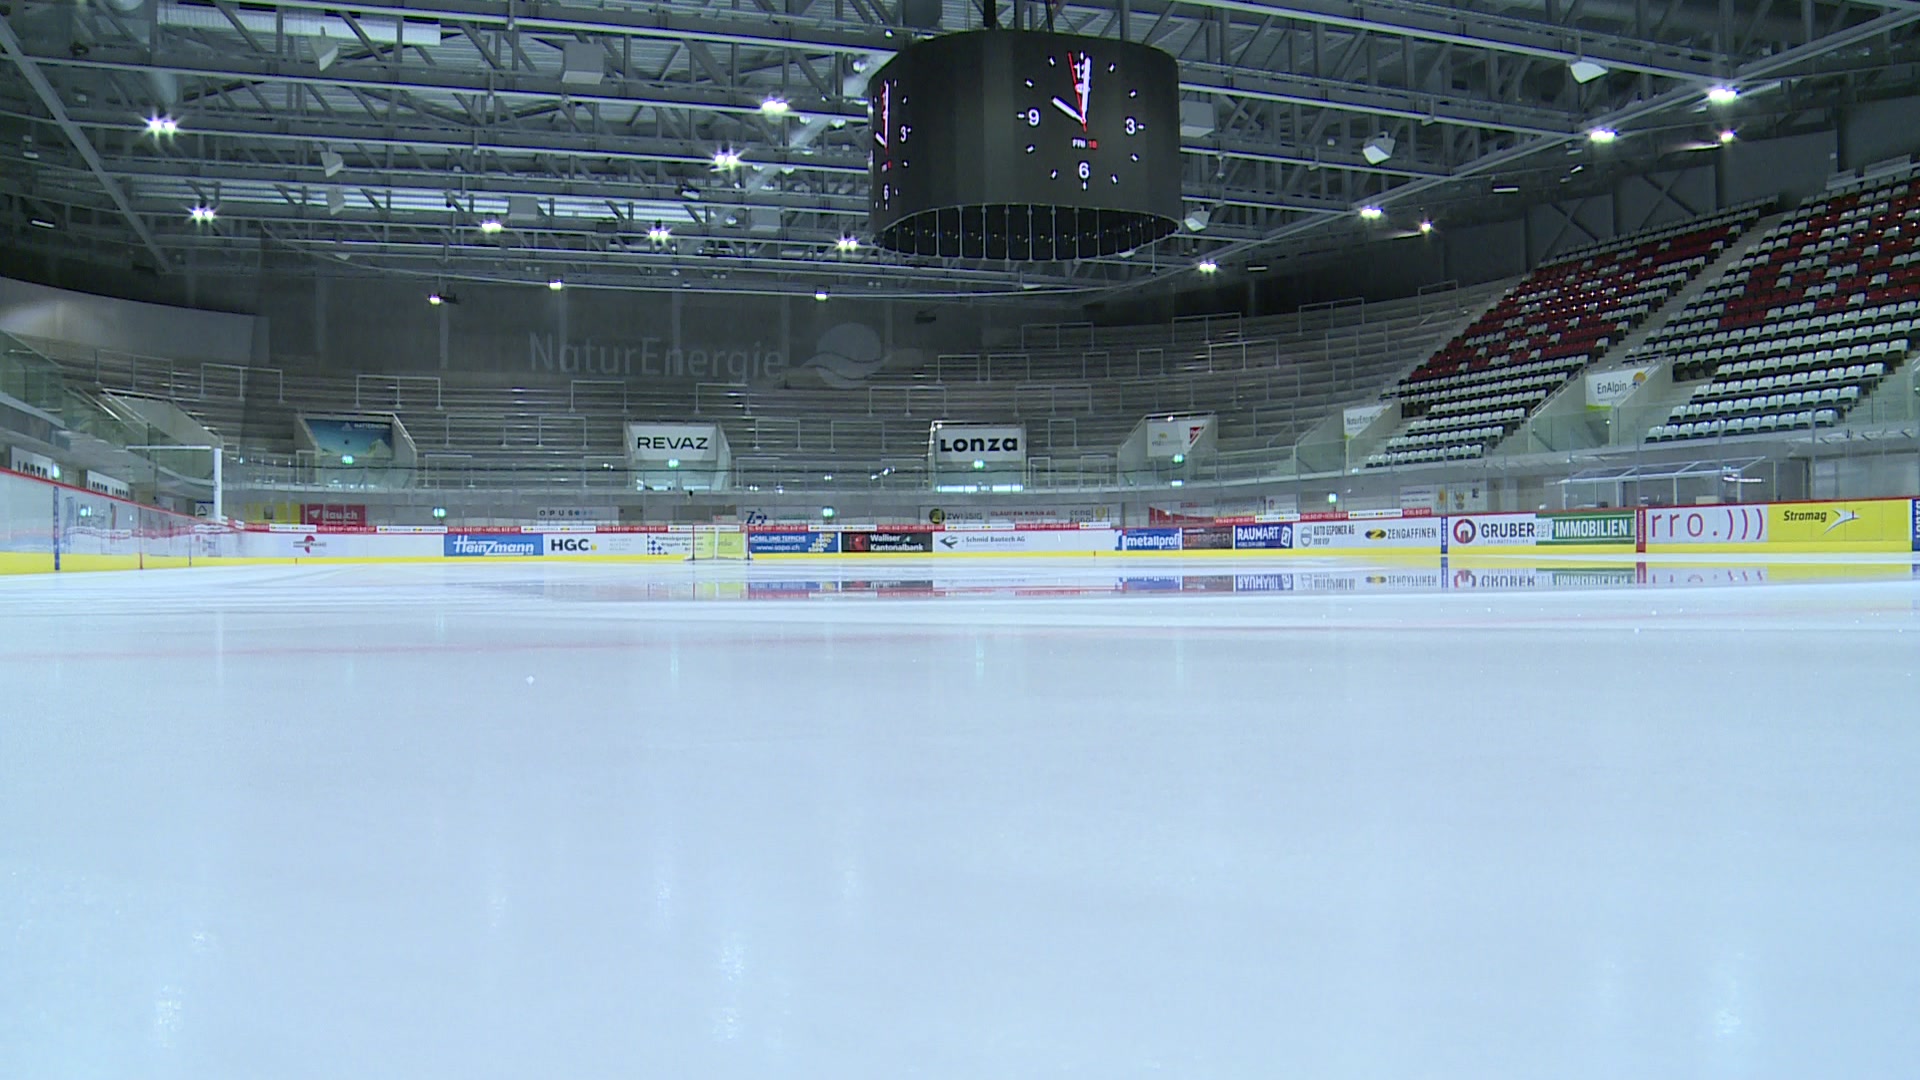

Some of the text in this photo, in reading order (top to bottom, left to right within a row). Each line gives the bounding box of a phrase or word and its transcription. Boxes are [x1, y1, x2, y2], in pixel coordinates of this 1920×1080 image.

[1028, 108, 1040, 126] 9
[900, 125, 907, 142] 3
[1125, 117, 1137, 136] 3
[1078, 161, 1090, 179] 6
[883, 184, 890, 200] 6
[529, 332, 783, 382] NaturEnergie
[1597, 379, 1628, 395] EnAlpin
[637, 436, 709, 450] REVAZ
[1783, 510, 1827, 522] Stromag
[1236, 527, 1280, 541] RAUMART
[1387, 527, 1437, 539] ZENGAFFINEN
[1481, 522, 1535, 538] GRUBER
[1555, 519, 1628, 537] IMMOBILIEN
[870, 534, 901, 542] Walliser
[1016, 535, 1026, 543] AG
[1126, 533, 1180, 550] metallprofi
[870, 543, 924, 551] Kantonalbank
